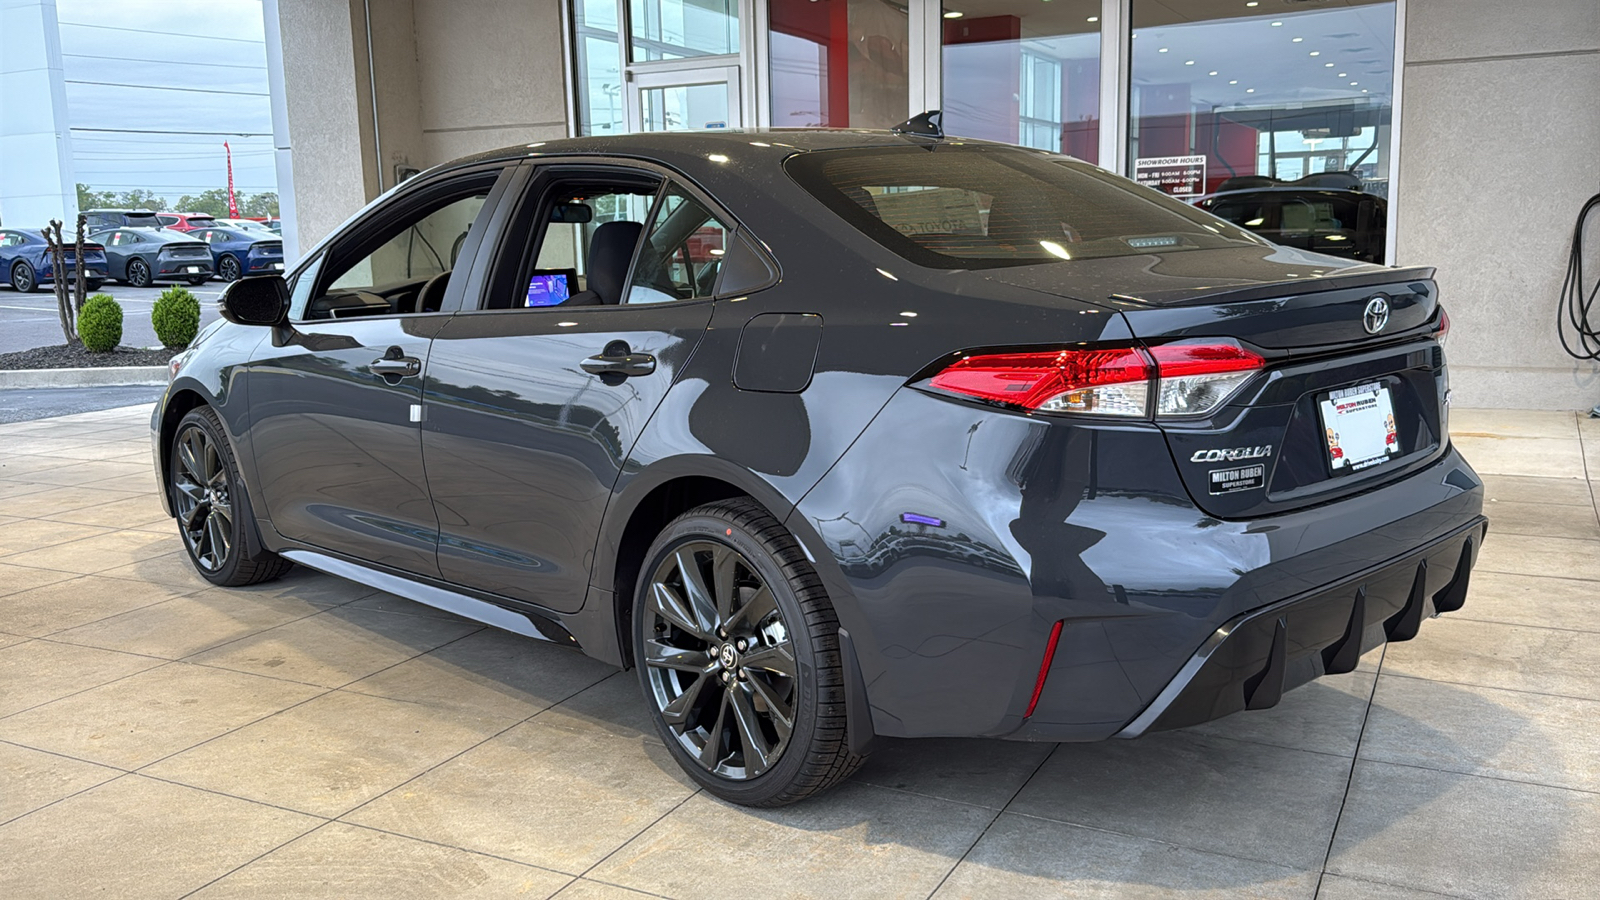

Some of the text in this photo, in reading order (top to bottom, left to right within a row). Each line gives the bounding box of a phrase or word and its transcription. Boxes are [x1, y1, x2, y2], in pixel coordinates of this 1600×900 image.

[1336, 397, 1377, 410] MILTON RUBEN
[1346, 404, 1378, 413] SUPERSTORE
[1190, 445, 1272, 462] COROLLA
[1212, 466, 1262, 483] MILTON RUBEN
[1222, 479, 1255, 488] SUPERSTORE
